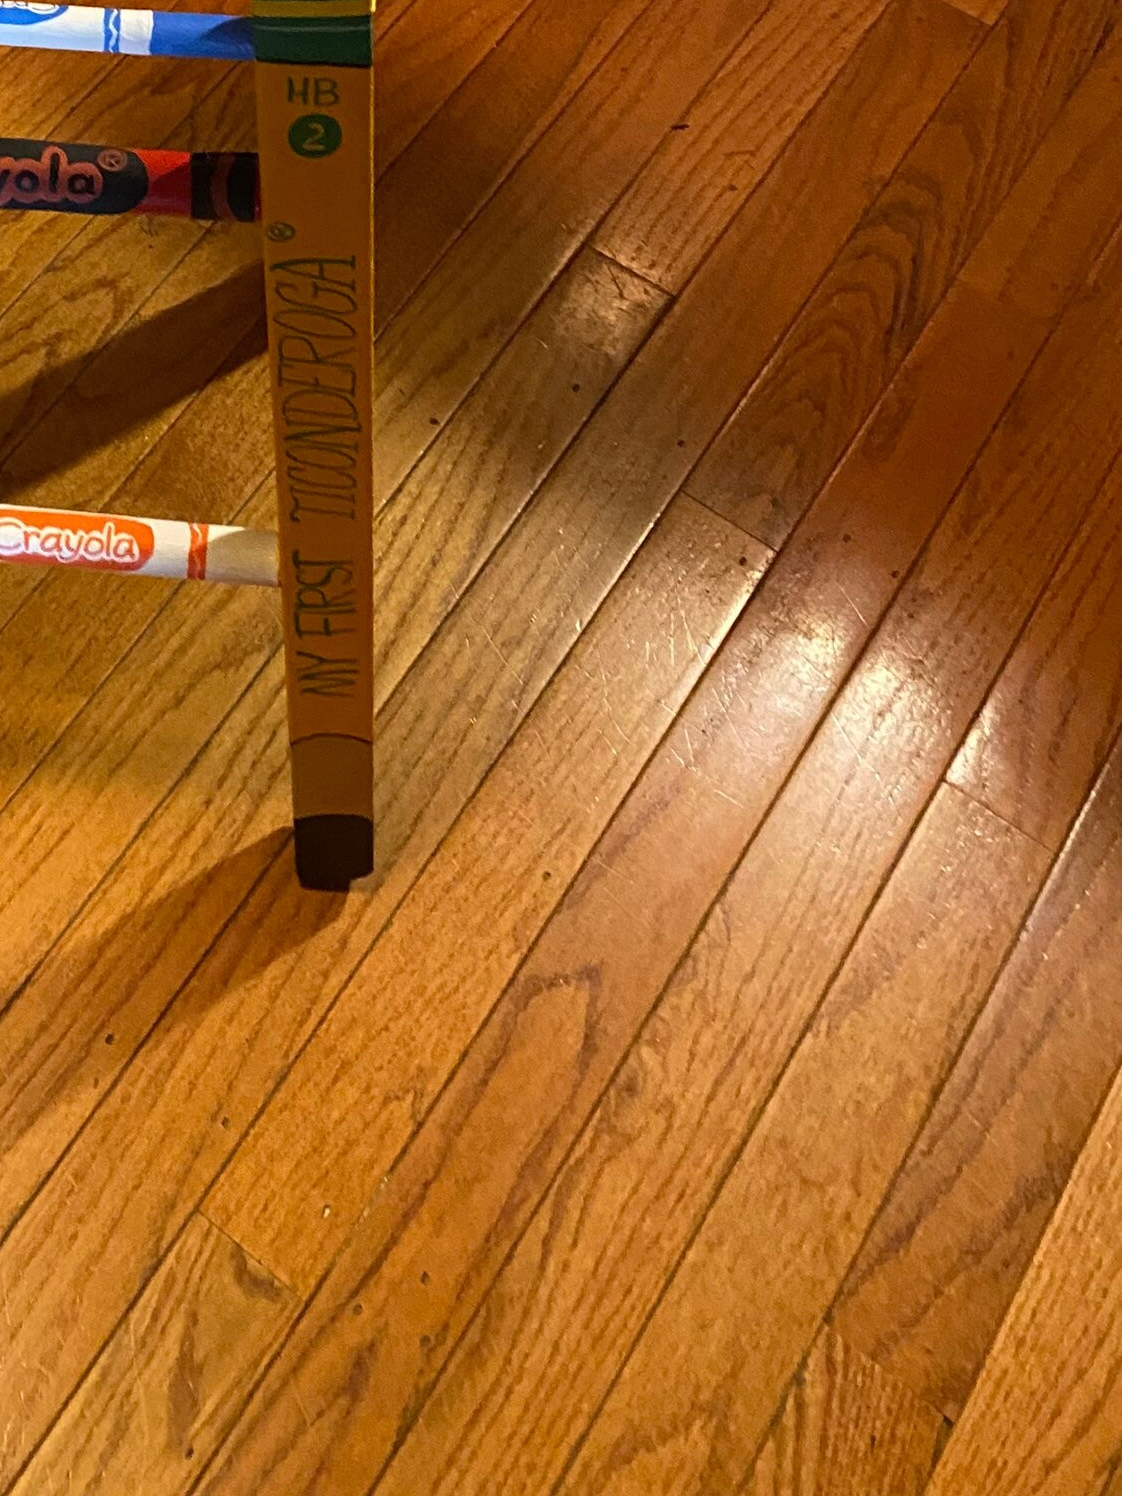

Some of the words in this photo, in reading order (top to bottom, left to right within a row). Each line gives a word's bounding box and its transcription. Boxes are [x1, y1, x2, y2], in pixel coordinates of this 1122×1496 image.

[286, 76, 340, 106] HB
[301, 121, 327, 152] 2
[269, 254, 363, 524] TICONDEROGA
[291, 548, 358, 640] FIRST
[296, 649, 360, 698] MY
